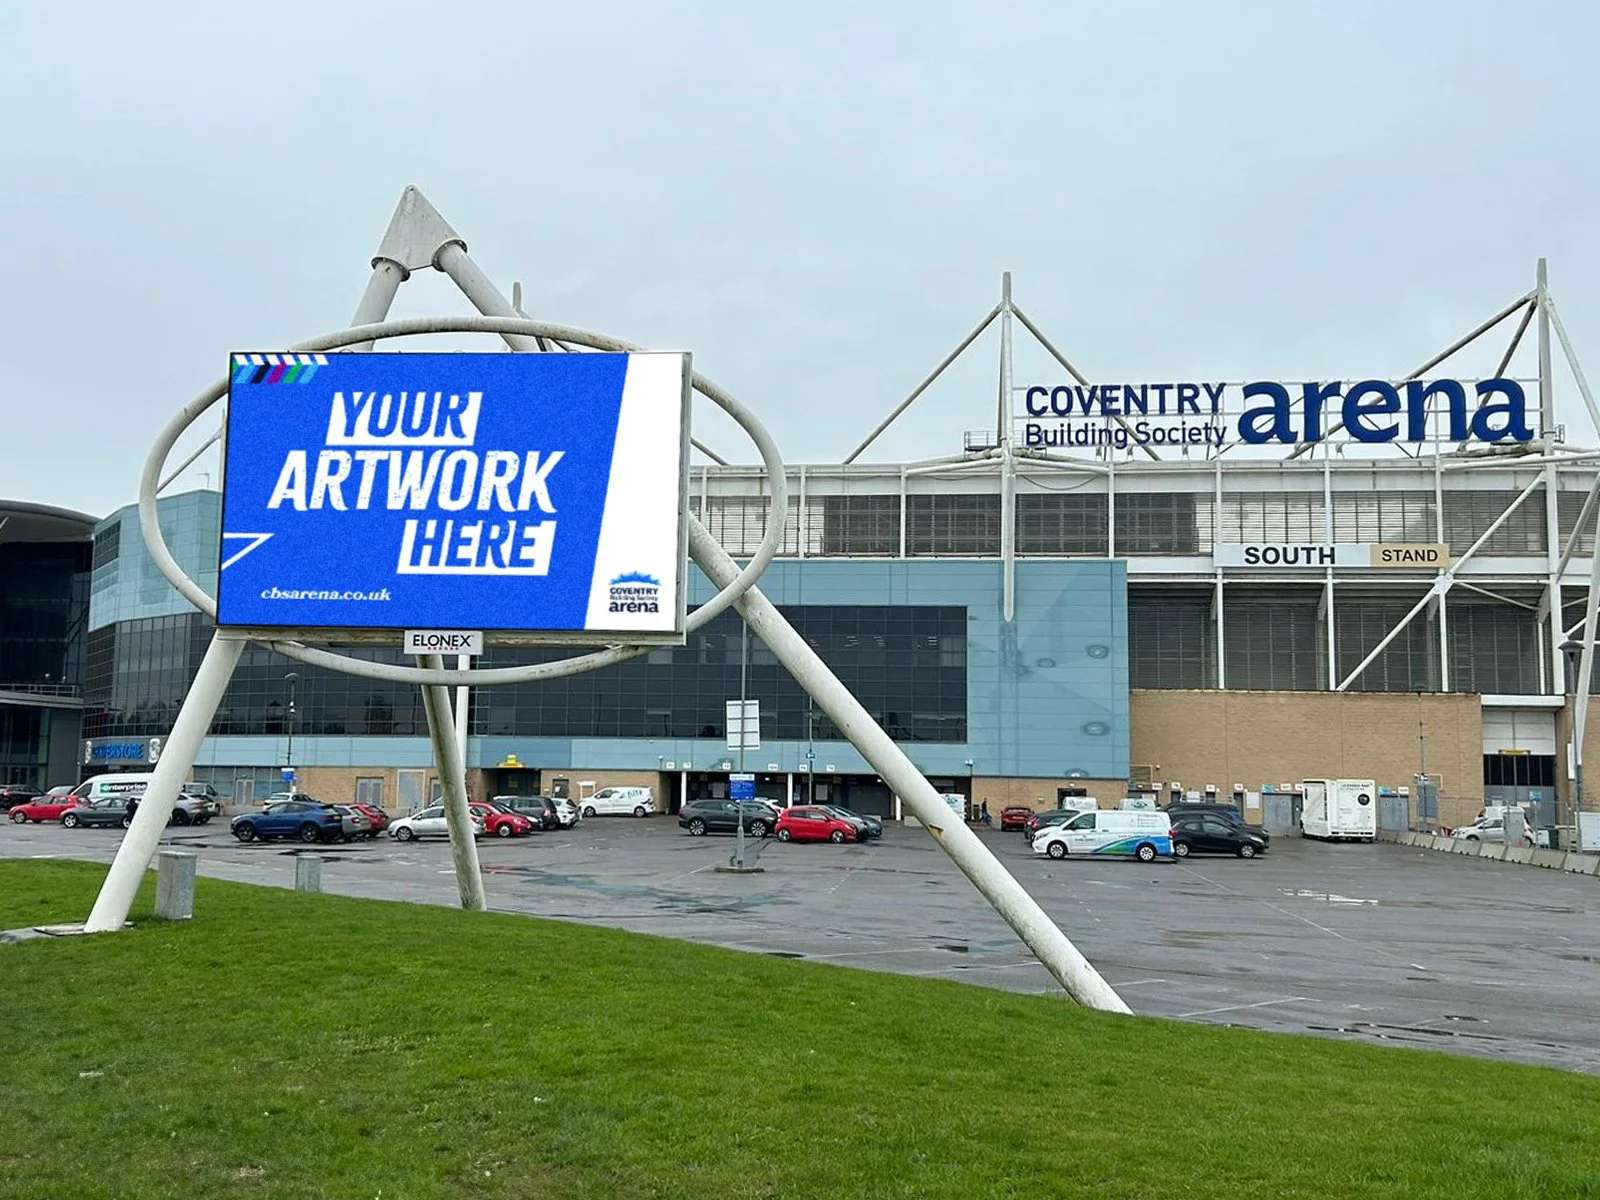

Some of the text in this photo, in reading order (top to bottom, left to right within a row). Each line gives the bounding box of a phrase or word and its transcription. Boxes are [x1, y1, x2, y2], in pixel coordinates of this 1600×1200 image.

[1026, 383, 1226, 416] COVENTRY
[1238, 378, 1533, 443] arena
[341, 391, 470, 438] YOUR
[1026, 422, 1227, 450] Building Society
[267, 449, 566, 513] ARTWORK
[408, 520, 543, 568] HERE
[1244, 546, 1438, 566] SOUTH STAND
[260, 586, 391, 601] cbsarena.co.uk
[610, 587, 658, 595] COVENTRY
[609, 601, 659, 612] arena
[413, 634, 471, 647] ELONEX
[102, 784, 147, 793] enterprise
